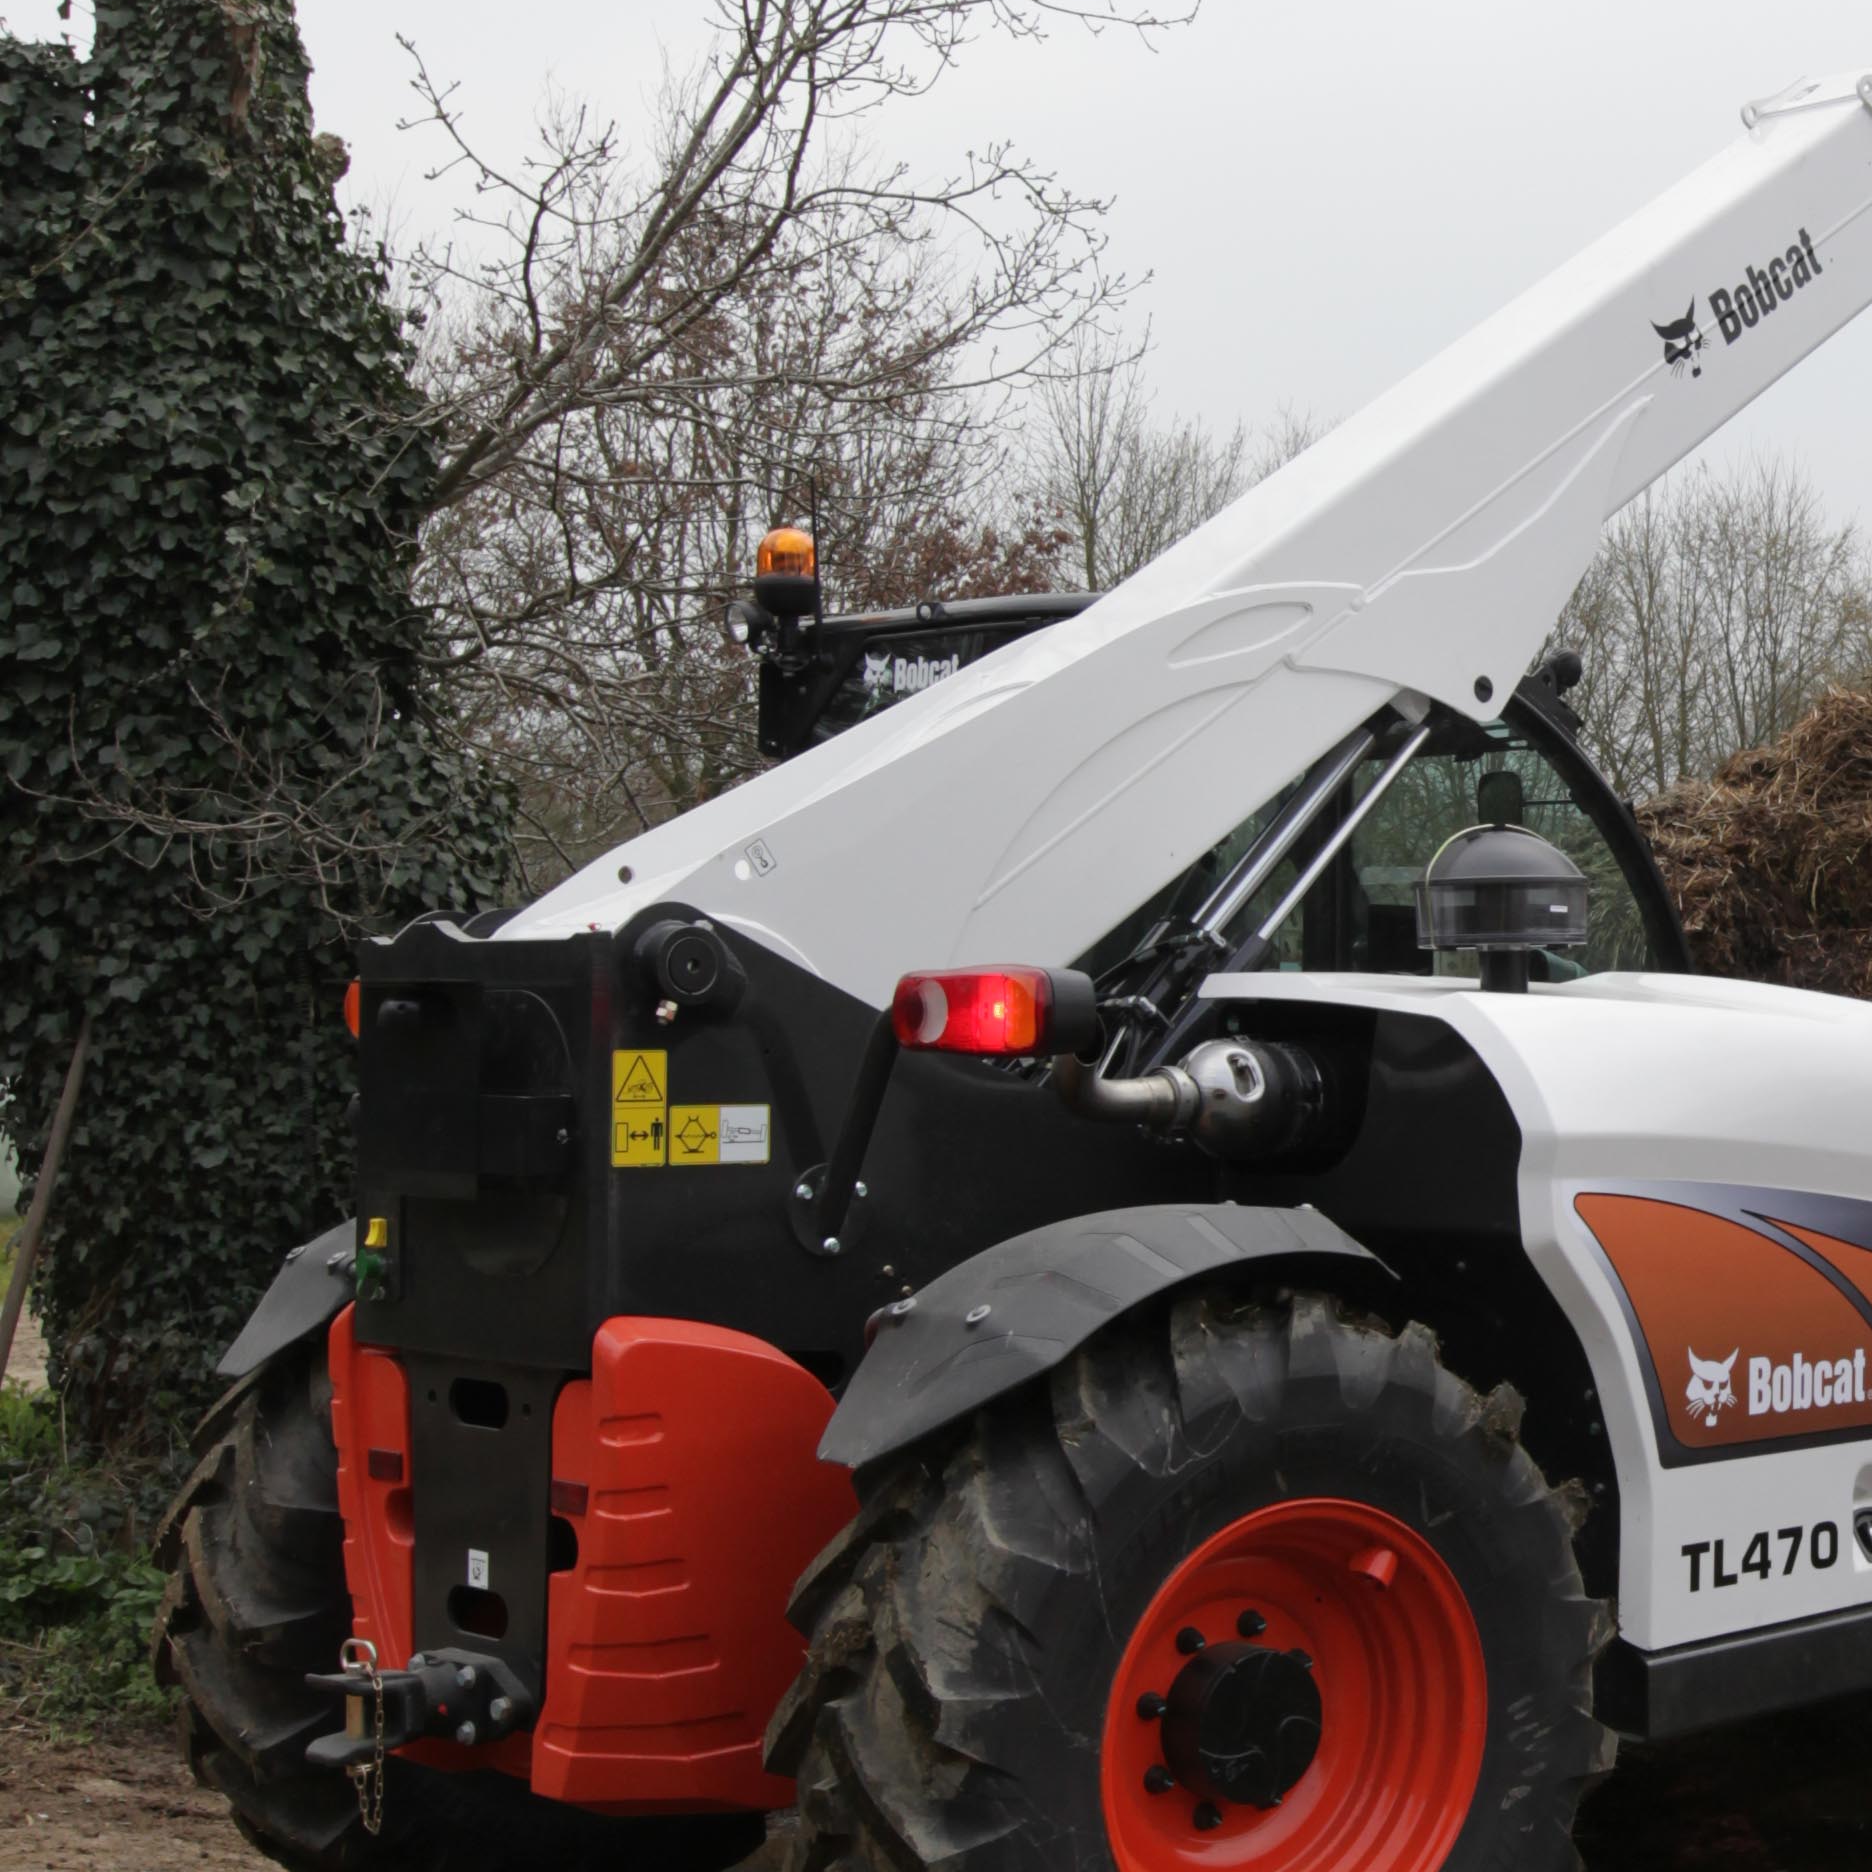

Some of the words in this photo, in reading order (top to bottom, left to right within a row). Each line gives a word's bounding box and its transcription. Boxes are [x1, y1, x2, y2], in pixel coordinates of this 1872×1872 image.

[1707, 227, 1823, 346] Bobcat
[1748, 1348, 1866, 1416] Bobcat
[1681, 1520, 1839, 1593] TL470
